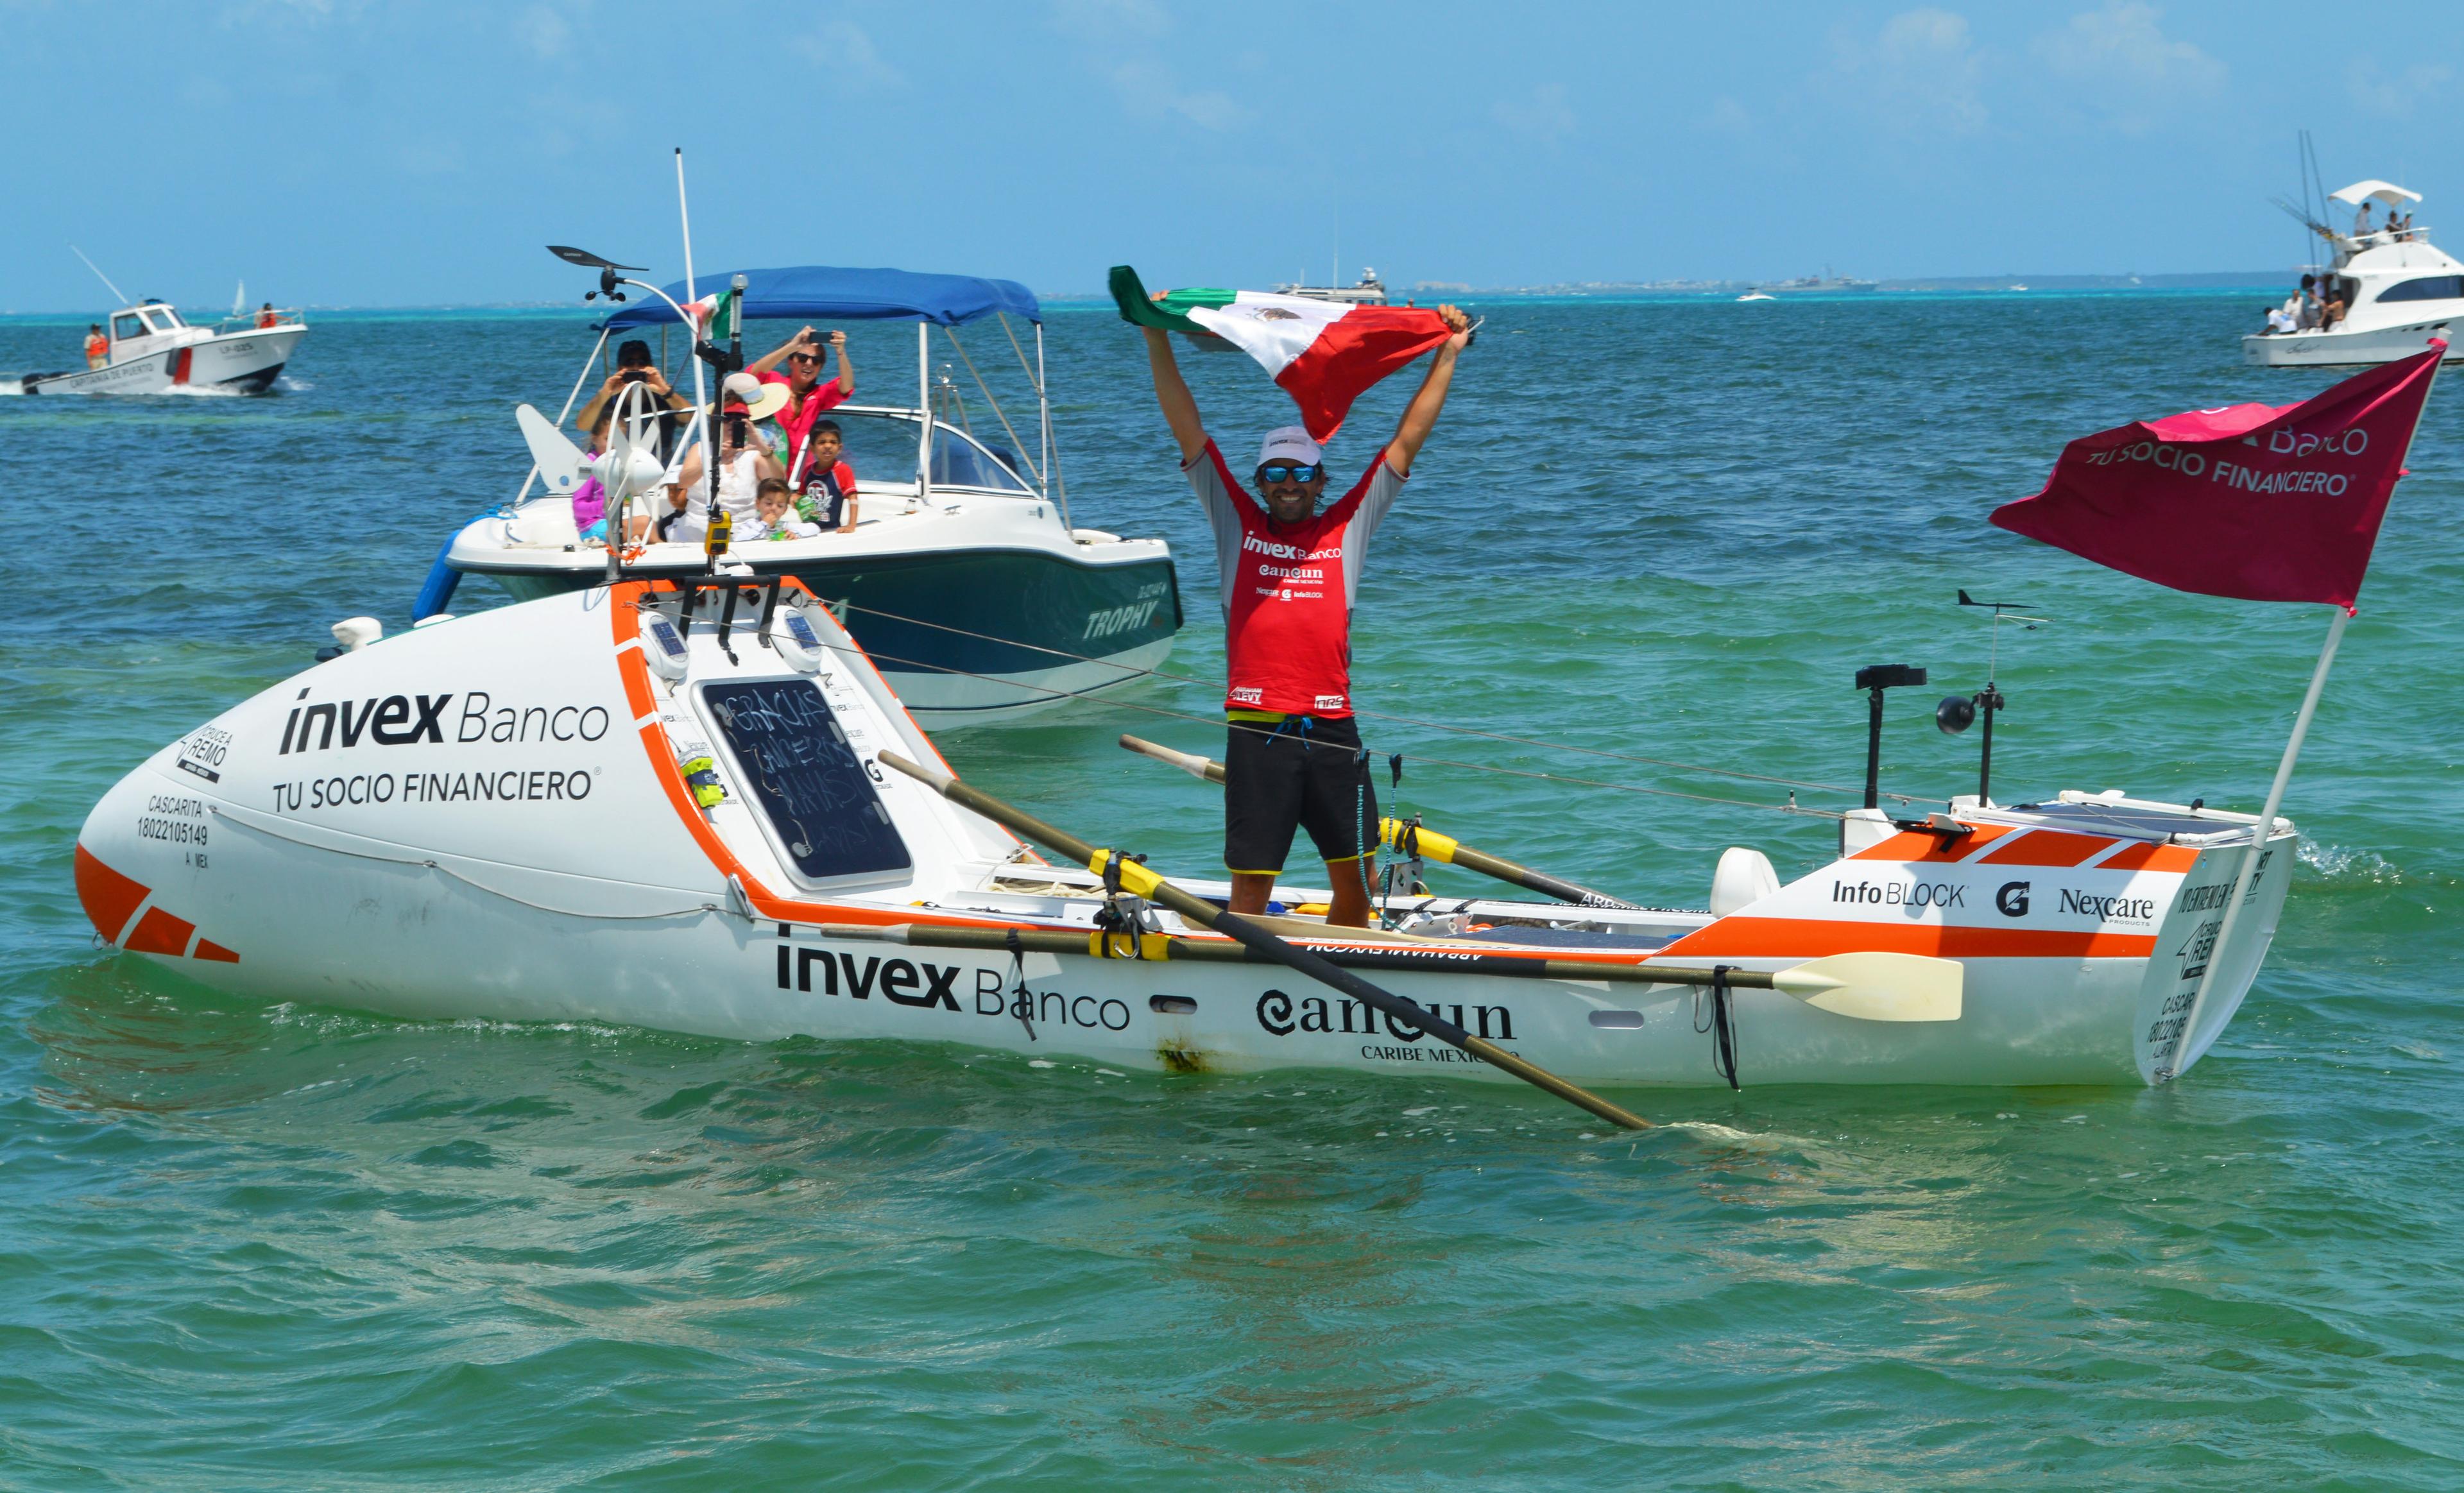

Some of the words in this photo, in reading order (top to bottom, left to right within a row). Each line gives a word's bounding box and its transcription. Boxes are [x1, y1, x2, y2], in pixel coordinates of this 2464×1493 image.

[2116, 441, 2206, 476] SOCIO
[2211, 460, 2348, 497] FINANCIERO
[1243, 530, 1297, 559] invex
[1297, 547, 1342, 560] Banco
[1082, 600, 1159, 640] TROPHY
[726, 688, 828, 735] GRACIAS
[1237, 692, 1262, 702] LEVY
[278, 687, 454, 756] invex
[457, 691, 610, 743] Banco
[187, 738, 227, 767] REMO
[273, 781, 303, 813] TU
[311, 772, 395, 809] SOCIO
[403, 770, 592, 803] FINANCIERO
[148, 795, 202, 819] CASCARITA
[137, 816, 208, 846] 18022105149
[1996, 881, 2030, 918] G
[2058, 888, 2154, 923] Nexcare
[2109, 919, 2151, 927] PRODUCTS
[2200, 920, 2223, 938] CRUC
[776, 923, 963, 1012] invex
[975, 968, 1131, 1031] Banco
[2162, 991, 2196, 1016] CASCAR
[2146, 1016, 2188, 1043] 18022105
[1361, 1045, 1425, 1062] CARIBE
[1428, 1048, 1520, 1064] MEXIC
